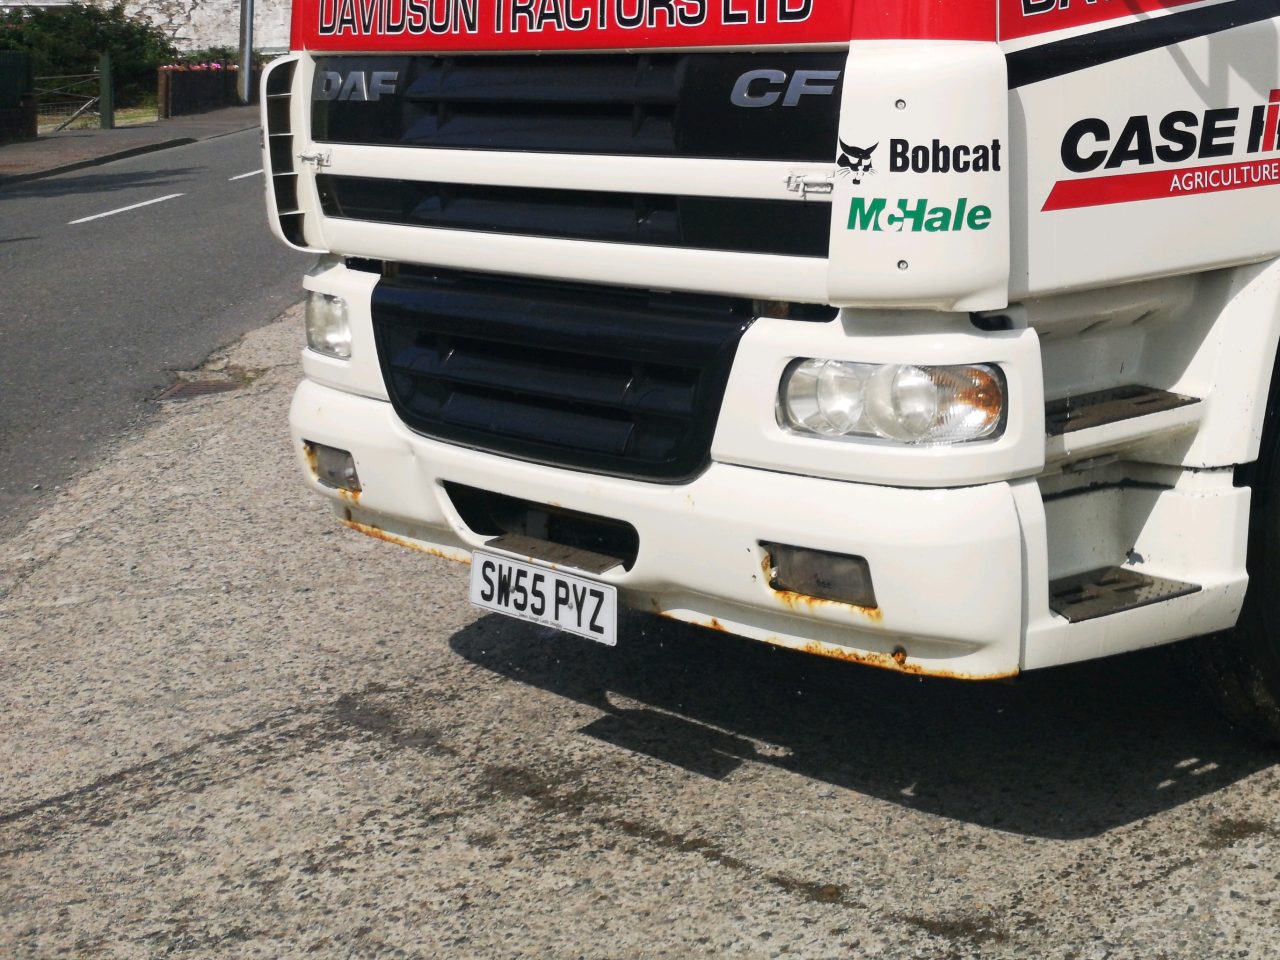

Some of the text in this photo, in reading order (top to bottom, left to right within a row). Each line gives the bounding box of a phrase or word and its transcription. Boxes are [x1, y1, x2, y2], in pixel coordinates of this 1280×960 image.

[315, 70, 399, 101] DAF
[730, 69, 841, 108] CF
[889, 138, 1001, 174] Bobcat
[1060, 106, 1240, 173] CASE
[1169, 162, 1280, 192] AGRICULTURE
[846, 197, 992, 233] McHale
[480, 560, 605, 636] SW55 PYZ
